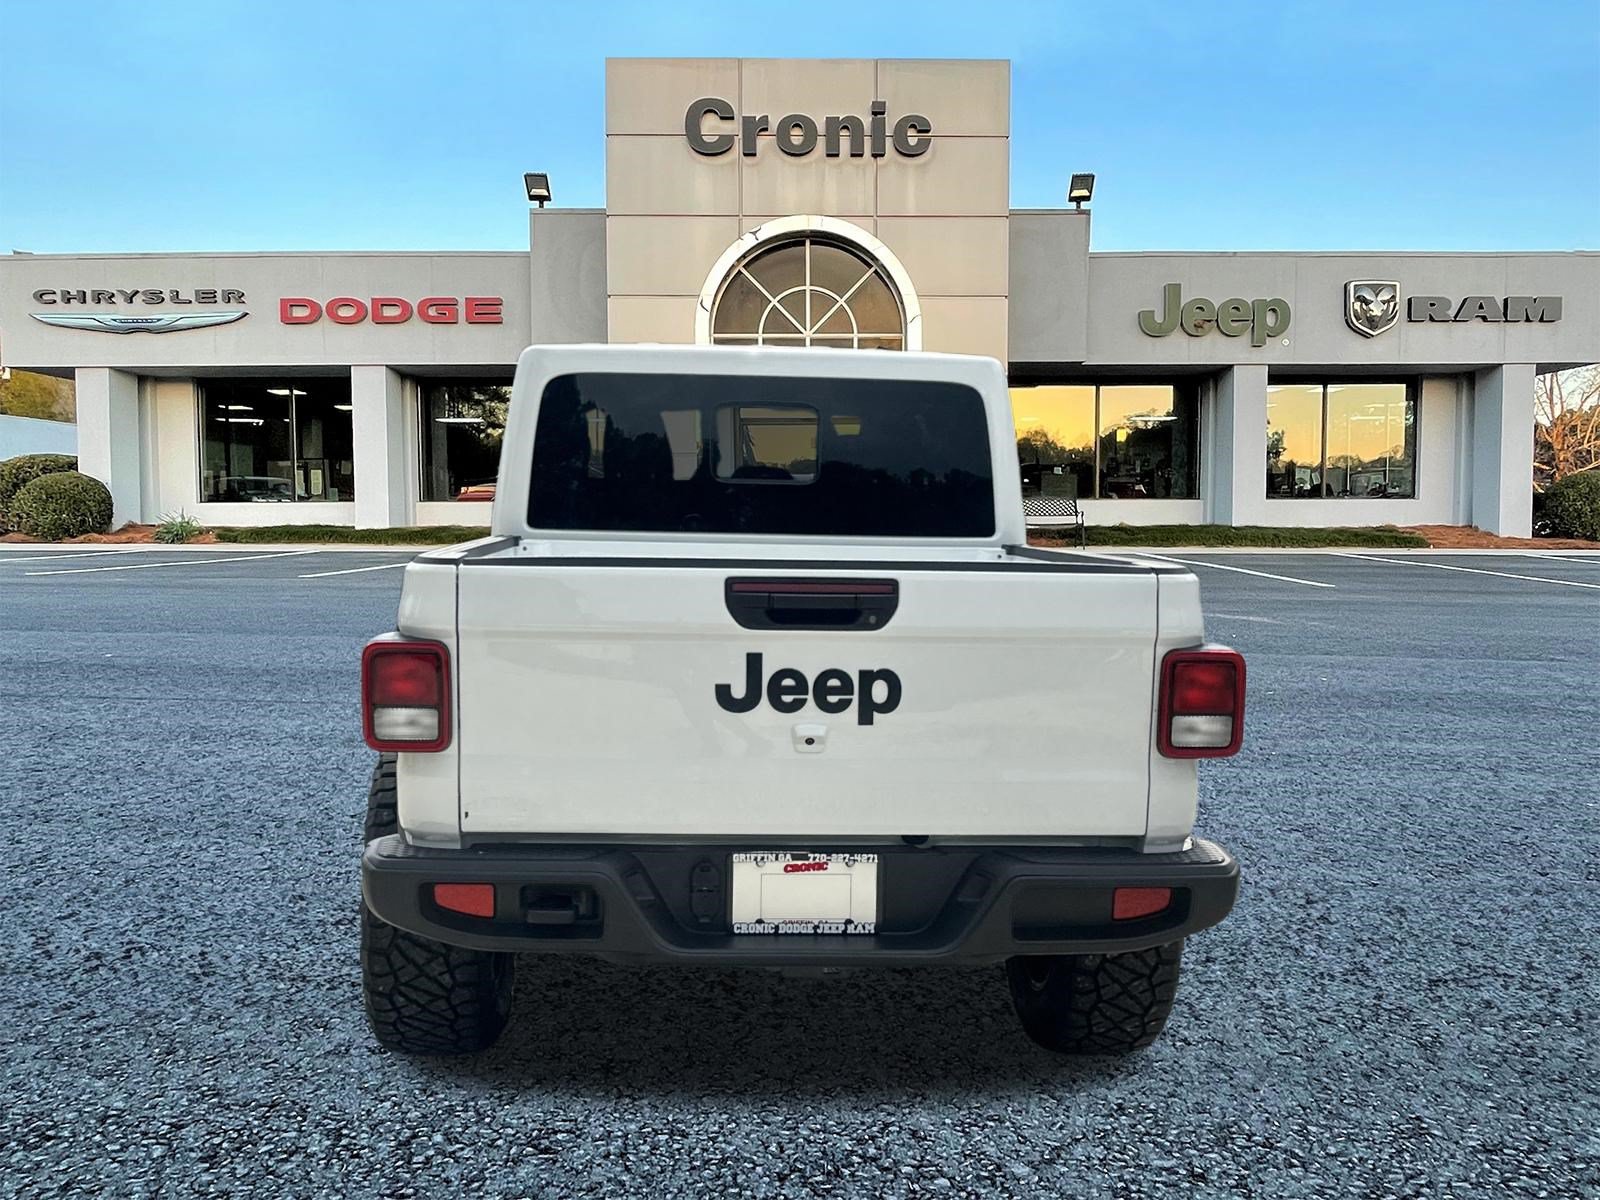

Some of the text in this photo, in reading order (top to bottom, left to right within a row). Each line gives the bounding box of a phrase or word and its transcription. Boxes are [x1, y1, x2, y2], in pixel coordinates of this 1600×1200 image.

[684, 97, 932, 157] Cronic
[33, 288, 248, 306] CHRYSLER
[1407, 296, 1563, 323] RAM
[279, 297, 504, 325] DODGE
[1138, 283, 1291, 347] Jeep
[714, 652, 902, 726] Jeep
[733, 853, 776, 862] GRIFFIN
[778, 853, 792, 862] GA
[783, 862, 829, 873] CRONIC
[733, 923, 876, 934] CRONIC DODGE JEEP RAM
